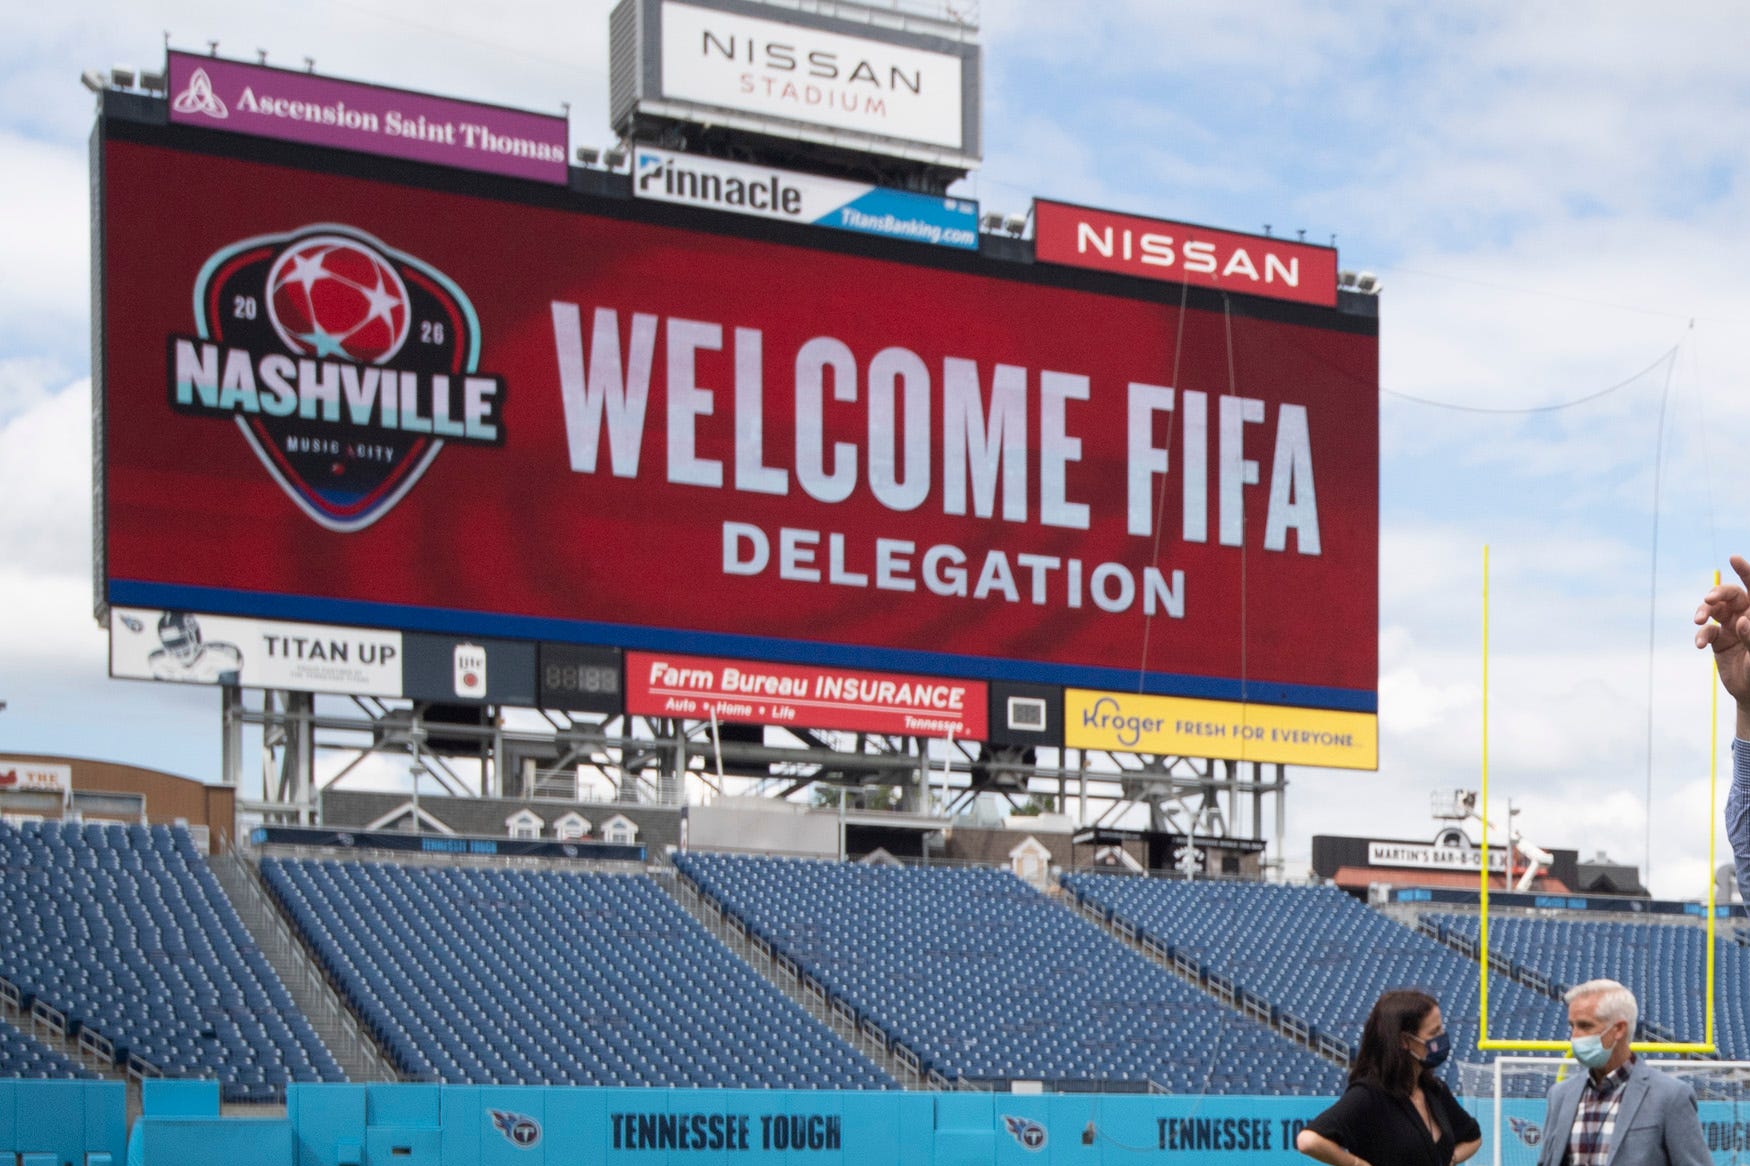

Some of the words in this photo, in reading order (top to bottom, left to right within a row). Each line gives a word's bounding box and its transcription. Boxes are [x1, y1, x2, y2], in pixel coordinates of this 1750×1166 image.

[702, 29, 922, 96] NISSAN
[738, 72, 888, 118] STADIUM
[236, 86, 379, 132] Ascension
[384, 111, 456, 144] Saint
[461, 123, 566, 164] Thomas
[638, 153, 802, 215] Pinnacle
[840, 208, 976, 246] TitansBanking.com
[1076, 222, 1300, 288] NISSAN
[233, 295, 257, 321] 20
[175, 338, 498, 441] NASHVILLE
[286, 434, 339, 456] MUSIC
[356, 443, 395, 463] CITY
[550, 300, 1091, 530] WELCOME
[1126, 381, 1323, 556] FIFA
[721, 521, 1187, 619] DELEGATION
[263, 635, 349, 663] TITAN
[358, 644, 397, 666] UP
[649, 661, 714, 689] Farm
[721, 668, 808, 698] Bureau
[815, 676, 966, 709] INSURANCE
[665, 697, 696, 713] Auto
[716, 700, 753, 717] Home
[771, 704, 796, 720] Life
[905, 716, 963, 733] Tennessee
[1081, 696, 1165, 747] Kroger
[1175, 720, 1227, 738] FRESH
[1232, 724, 1265, 741] FOR
[1271, 728, 1355, 748] EVERYONE
[1373, 848, 1429, 863] MARTIN'S
[611, 1112, 750, 1152] TENNESSEE
[760, 1113, 842, 1152] TOUGH
[1156, 1116, 1272, 1153] TENNESSEE
